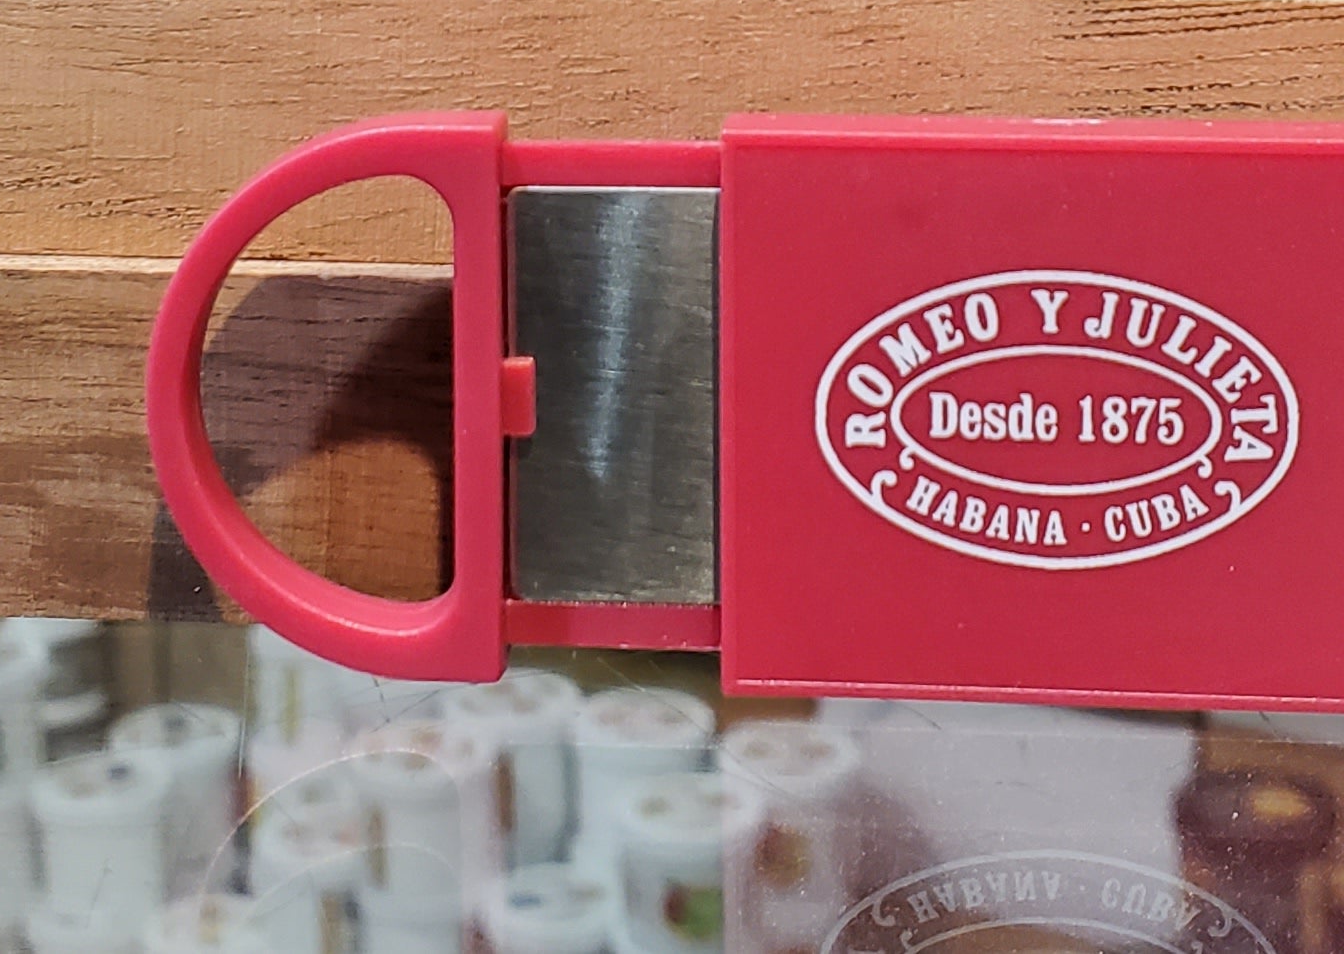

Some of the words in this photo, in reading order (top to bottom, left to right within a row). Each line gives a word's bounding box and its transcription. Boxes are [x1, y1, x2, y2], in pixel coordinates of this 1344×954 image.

[844, 292, 1000, 449] ROMEO
[1030, 288, 1070, 335] Y
[1083, 290, 1280, 464] JULIETA
[928, 391, 1060, 443] Desde
[1078, 394, 1185, 446] 1875
[906, 475, 1068, 546] HABANA
[1103, 484, 1211, 543] CUBA
